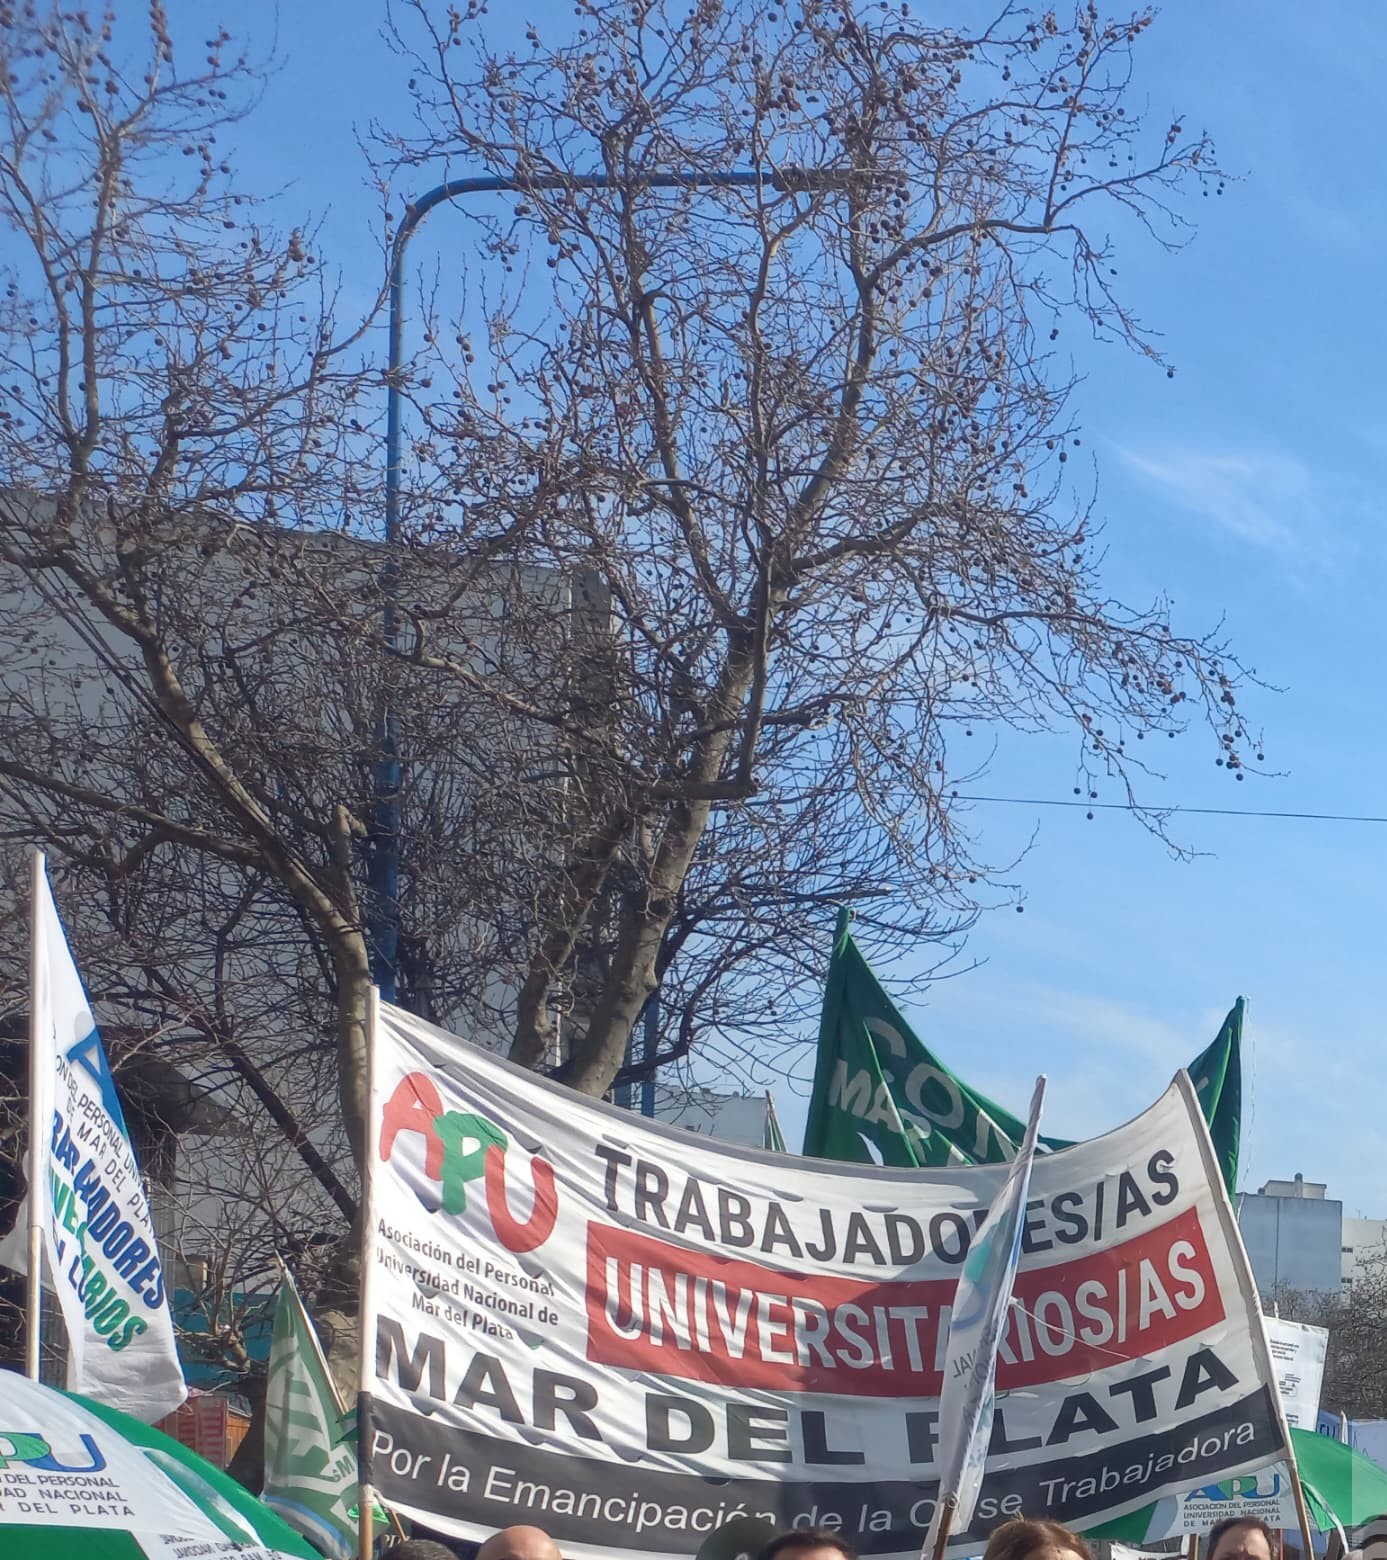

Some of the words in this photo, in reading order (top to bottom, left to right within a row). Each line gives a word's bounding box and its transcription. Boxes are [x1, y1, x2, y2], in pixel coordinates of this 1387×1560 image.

[379, 1071, 559, 1254] APU
[376, 1246, 459, 1294] Universidad
[464, 1283, 534, 1320] Nacional
[538, 1305, 559, 1326] de
[378, 1218, 451, 1265] Asociación
[457, 1253, 481, 1275] del
[485, 1262, 556, 1297] Personal
[412, 1292, 441, 1317] Mar
[444, 1304, 468, 1327] del
[472, 1313, 514, 1341] Plata
[375, 1313, 604, 1443] MAR
[645, 1392, 865, 1465] DEL
[20, 1502, 57, 1514] DEL
[71, 1503, 136, 1517] PLATA
[38, 1474, 121, 1489] PERSONAL
[39, 1487, 128, 1502] NACIONAL
[373, 1431, 433, 1481] Por
[437, 1454, 471, 1494] la
[792, 1501, 844, 1535] de
[857, 1499, 896, 1534] la
[910, 1490, 1024, 1528] Cse
[1039, 1421, 1256, 1509] Trabajadora
